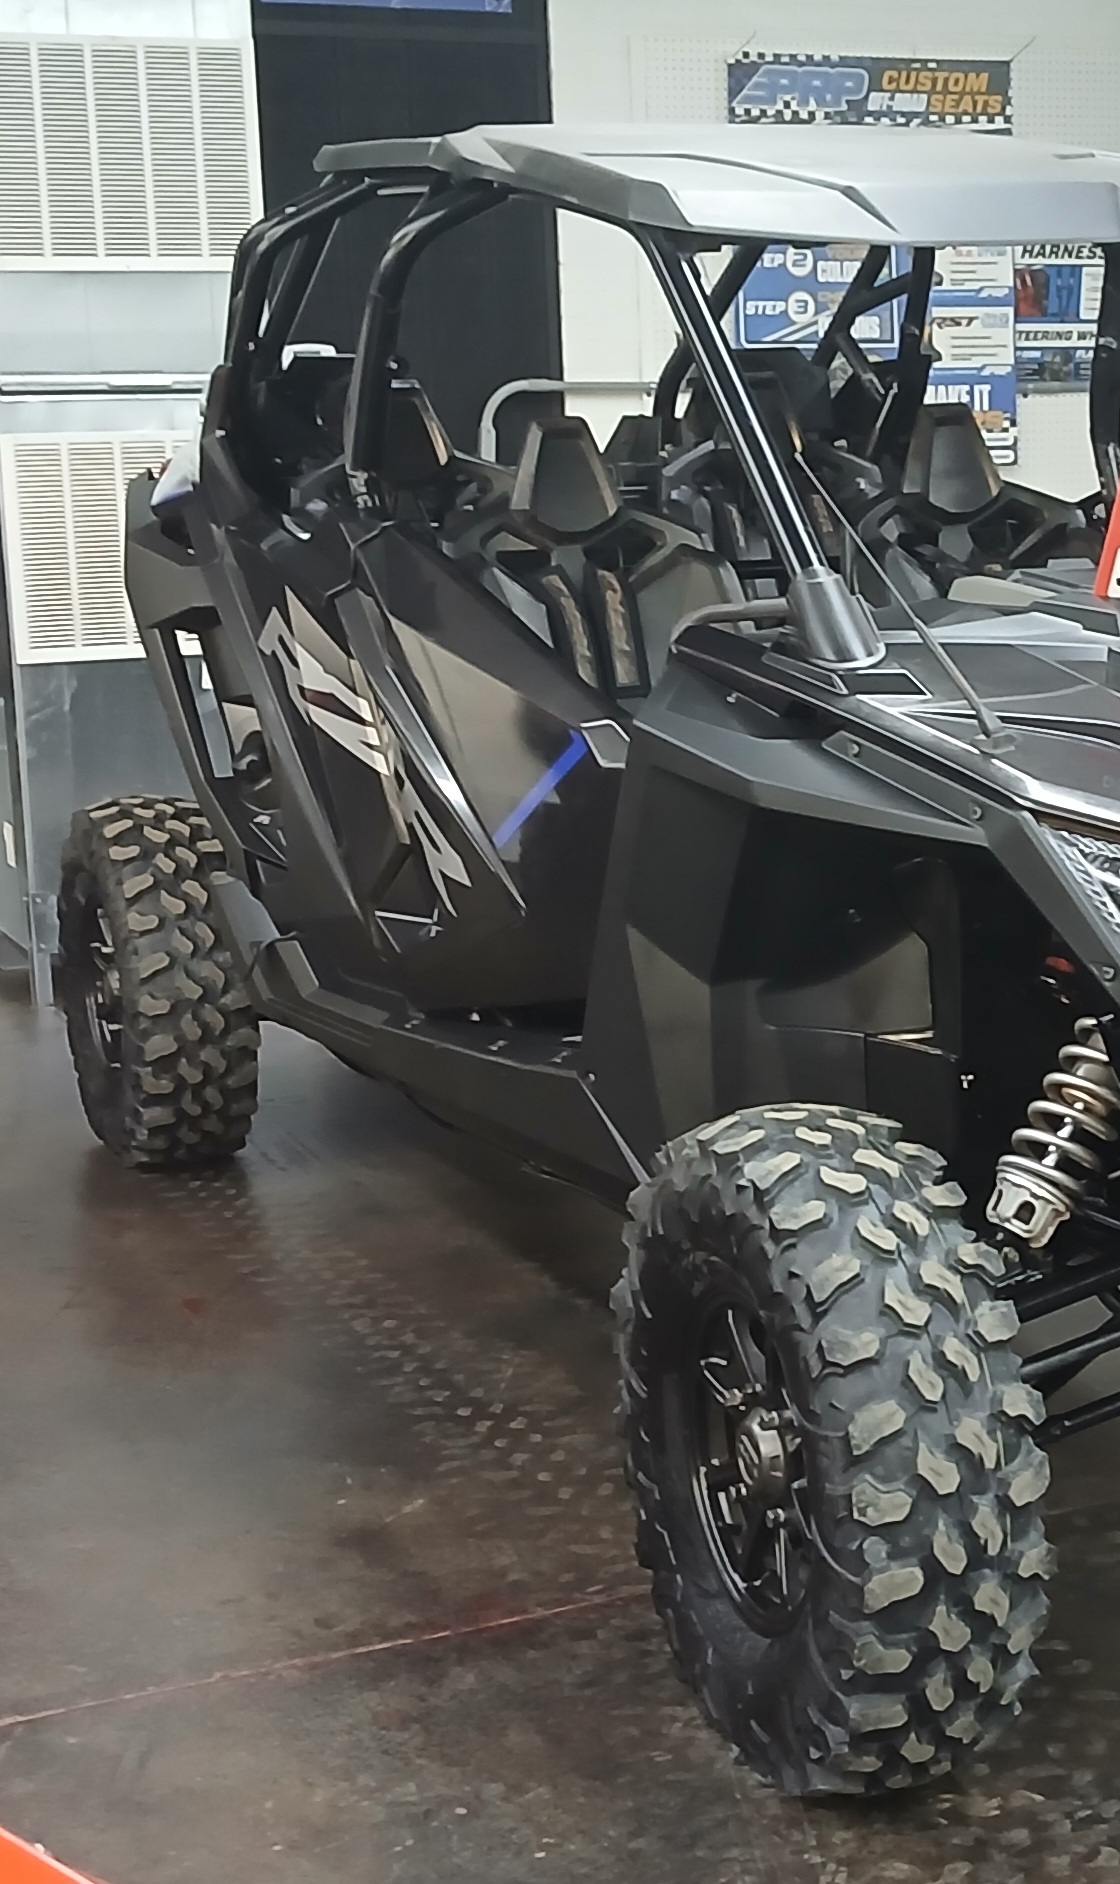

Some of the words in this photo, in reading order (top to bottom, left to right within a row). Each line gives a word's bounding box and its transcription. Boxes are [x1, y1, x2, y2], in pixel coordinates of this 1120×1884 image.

[881, 69, 989, 92] CUSTOM
[929, 94, 1003, 114] SEATS
[792, 252, 809, 269] 2
[745, 300, 787, 316] STEP
[794, 299, 809, 315] 3
[973, 384, 992, 411] IT
